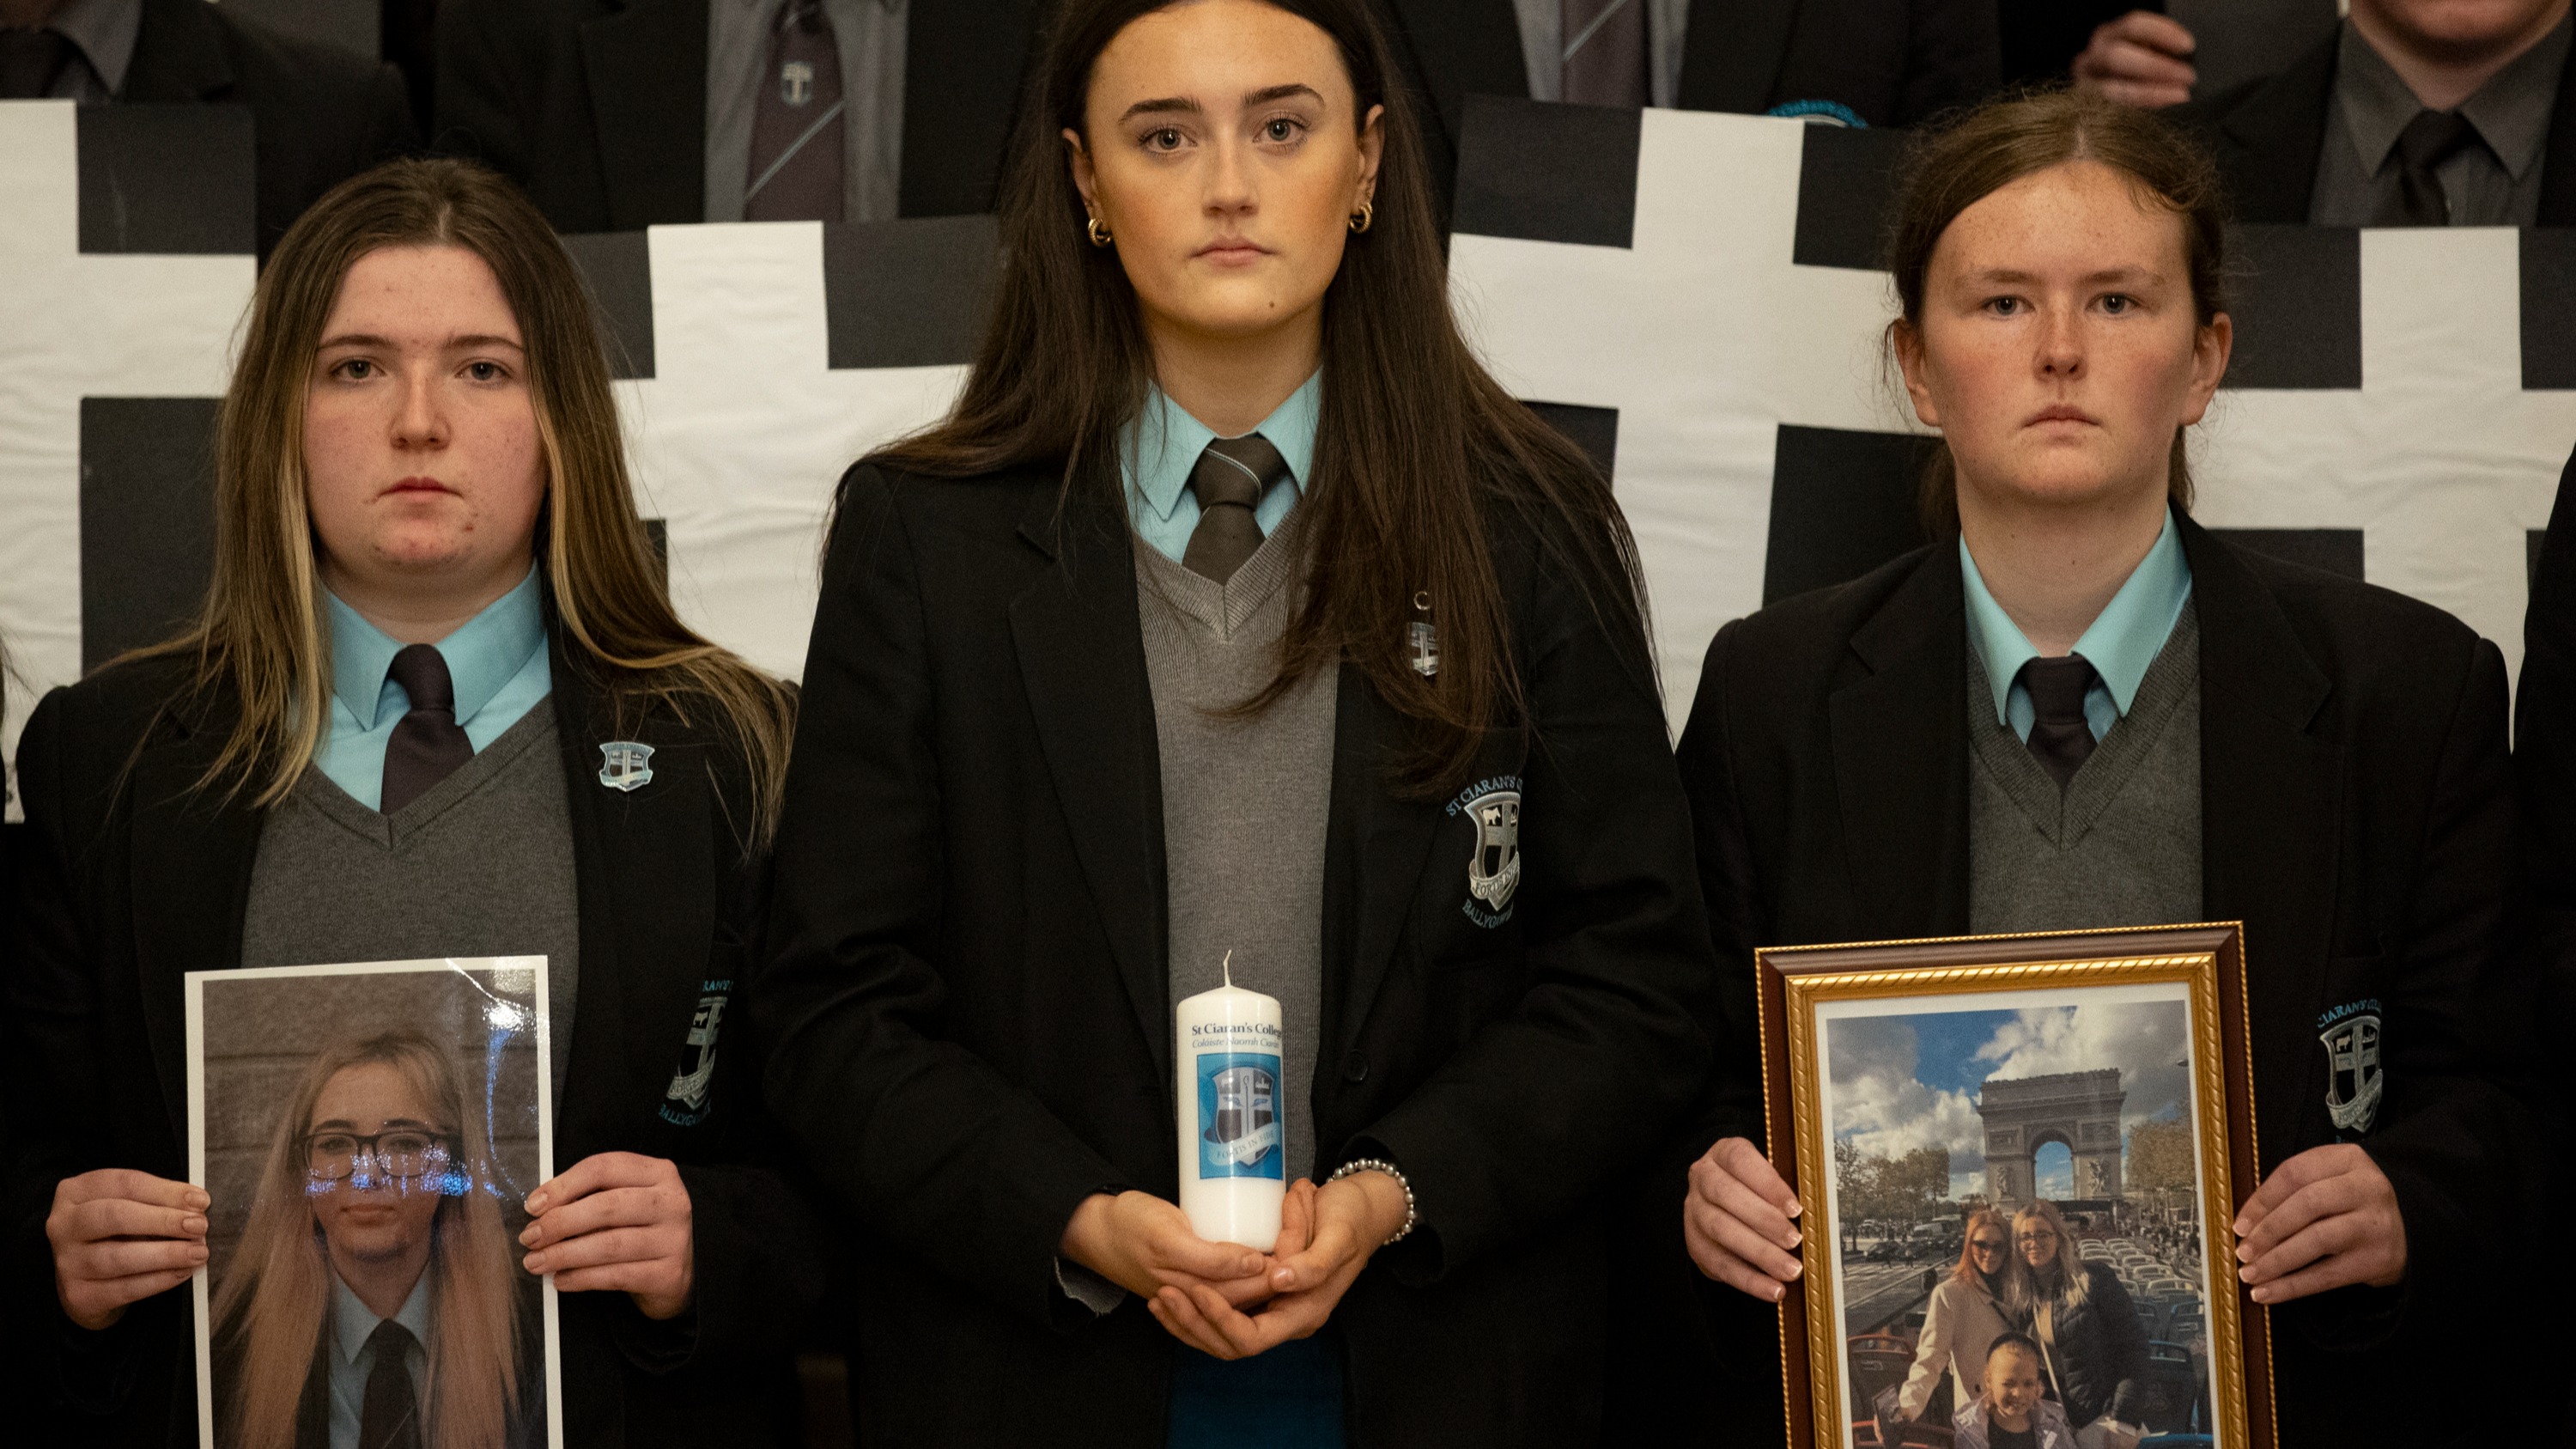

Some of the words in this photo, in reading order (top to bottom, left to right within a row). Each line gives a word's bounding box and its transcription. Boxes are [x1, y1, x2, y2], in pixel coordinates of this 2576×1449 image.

[1445, 797, 1462, 817] ST
[1459, 775, 1516, 803] CIARAN'S
[1192, 1025, 1202, 1036] St
[1204, 1022, 1253, 1035] Ciaran's
[1255, 1023, 1282, 1040] Colleg
[1192, 1038, 1216, 1049] Coláiste
[1226, 1037, 1259, 1046] Naomh
[1216, 1144, 1248, 1160] FOTIS
[1248, 1138, 1258, 1149] IN
